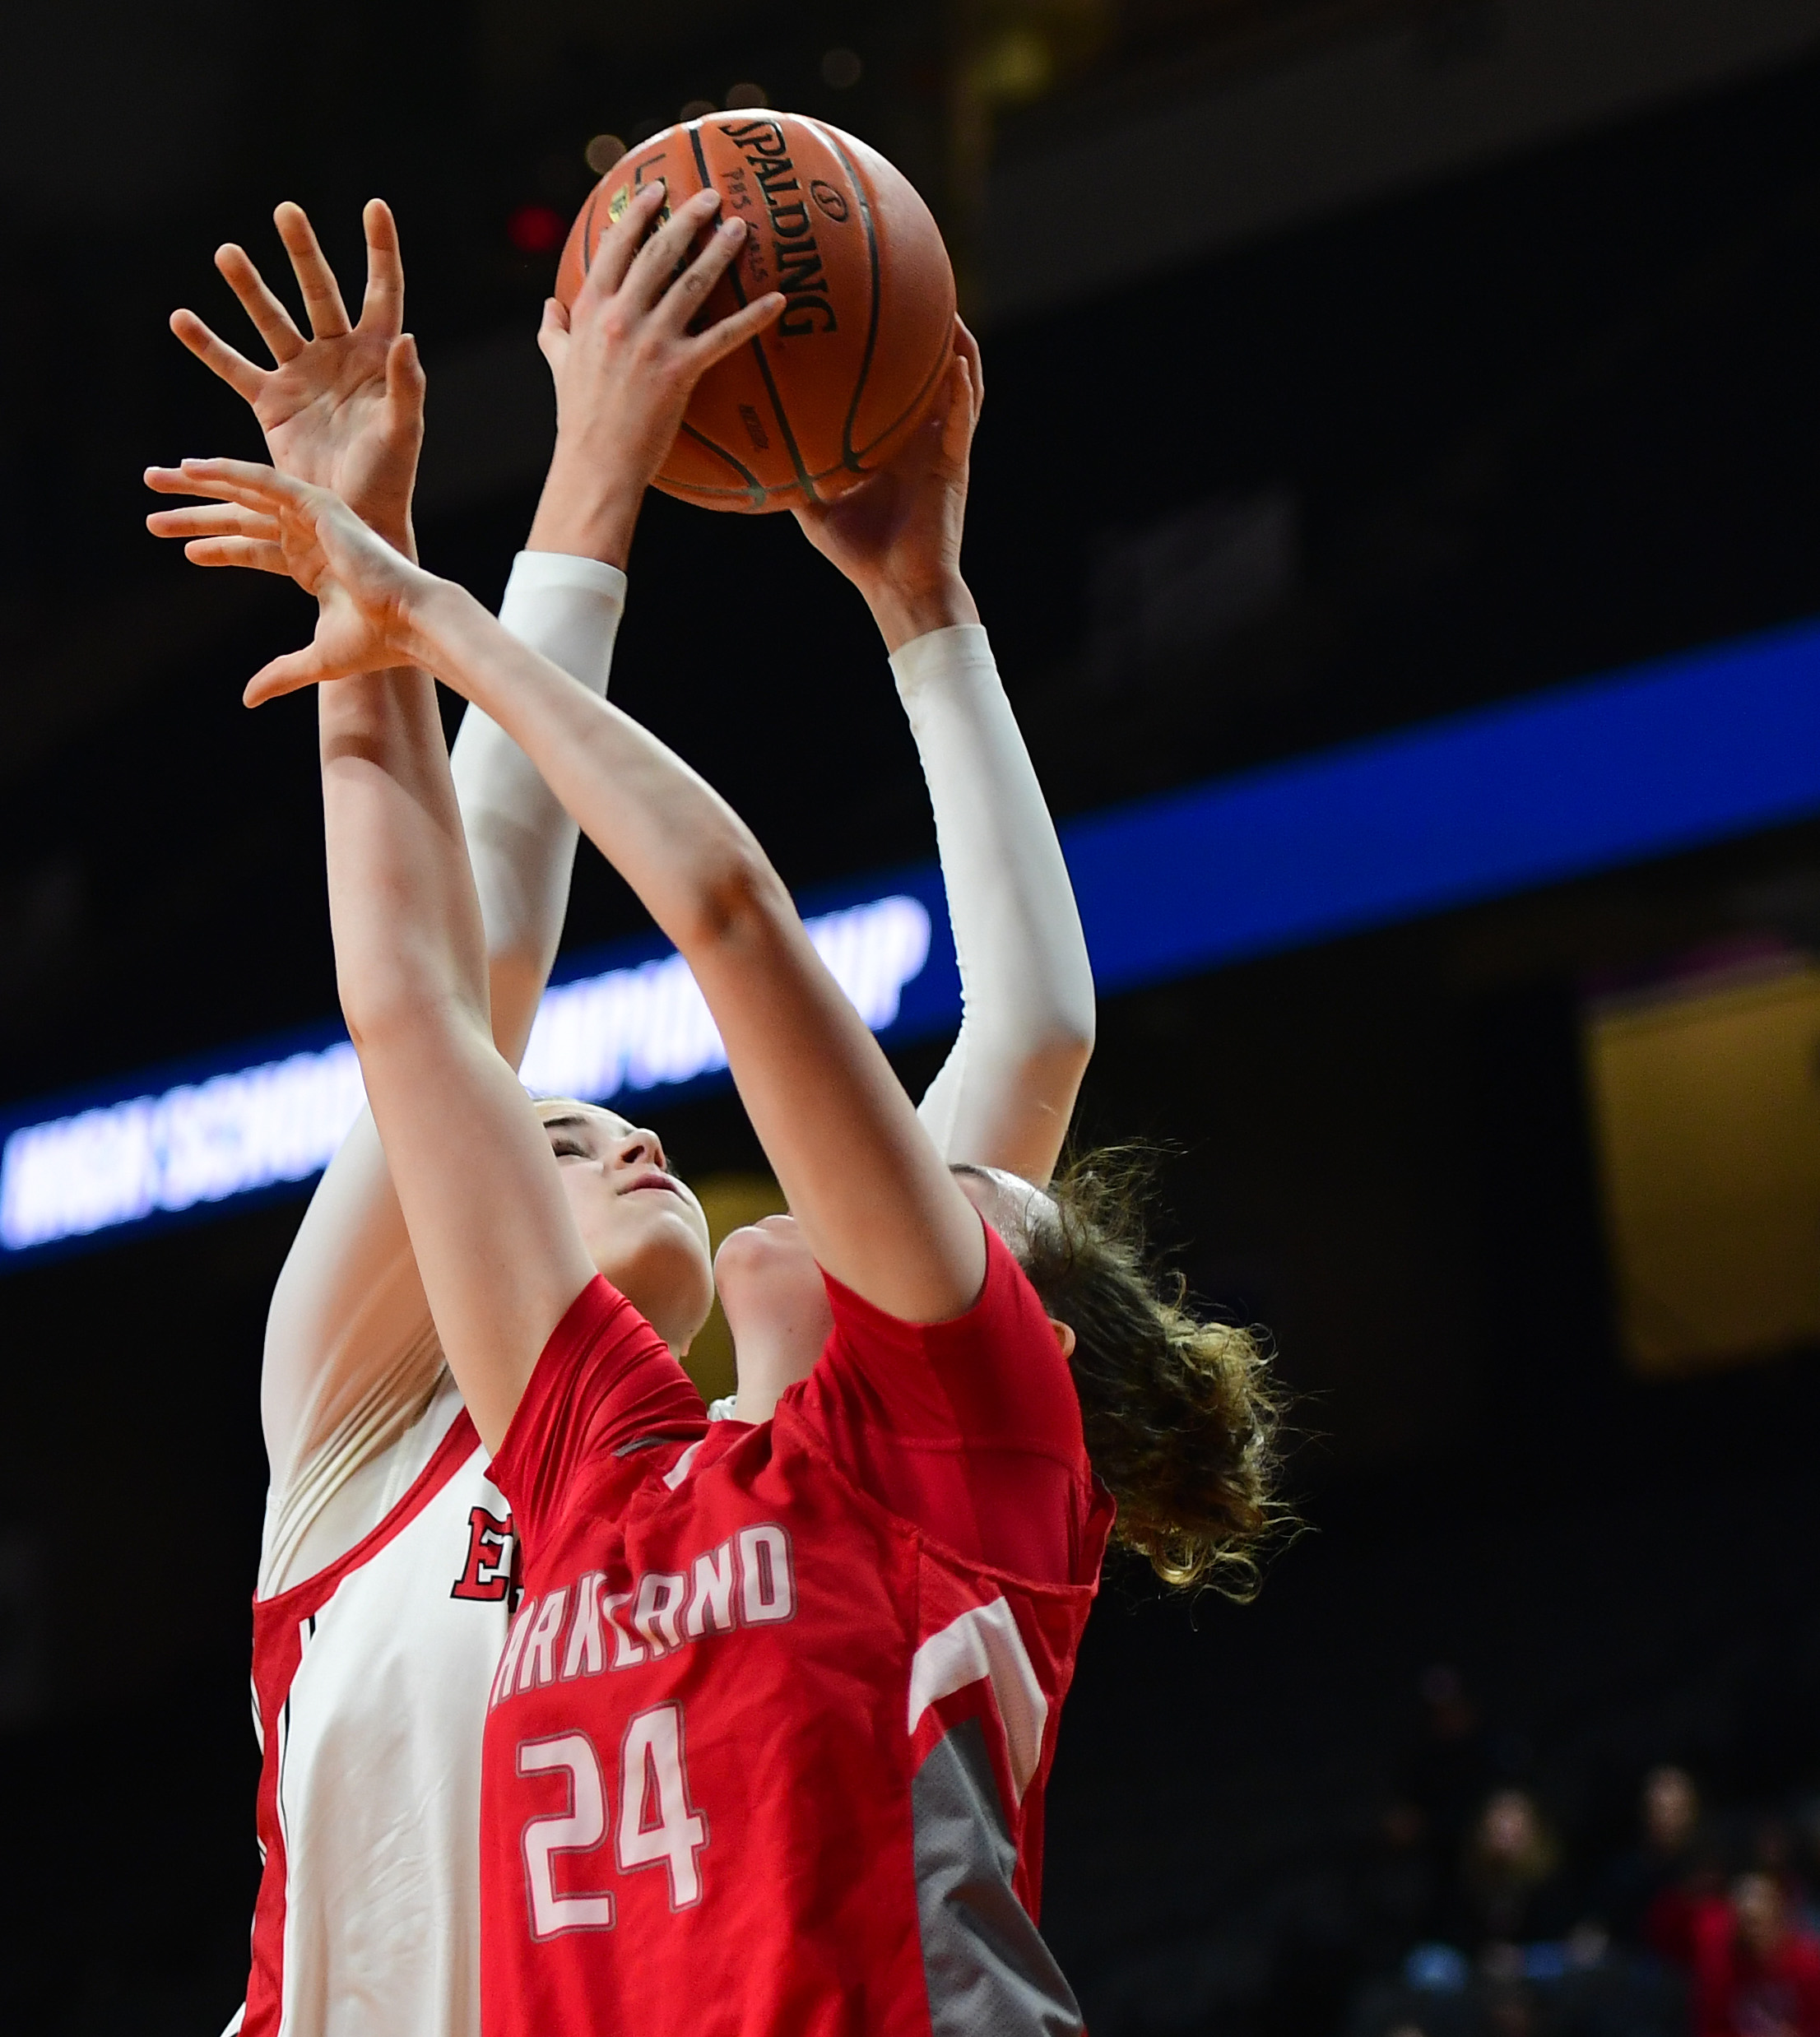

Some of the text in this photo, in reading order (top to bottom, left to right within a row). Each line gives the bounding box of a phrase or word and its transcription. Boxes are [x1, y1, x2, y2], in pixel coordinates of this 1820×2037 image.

[720, 119, 837, 338] SPALDING
[489, 1522, 798, 1715] ARKLAND
[516, 1700, 710, 1942] 24
